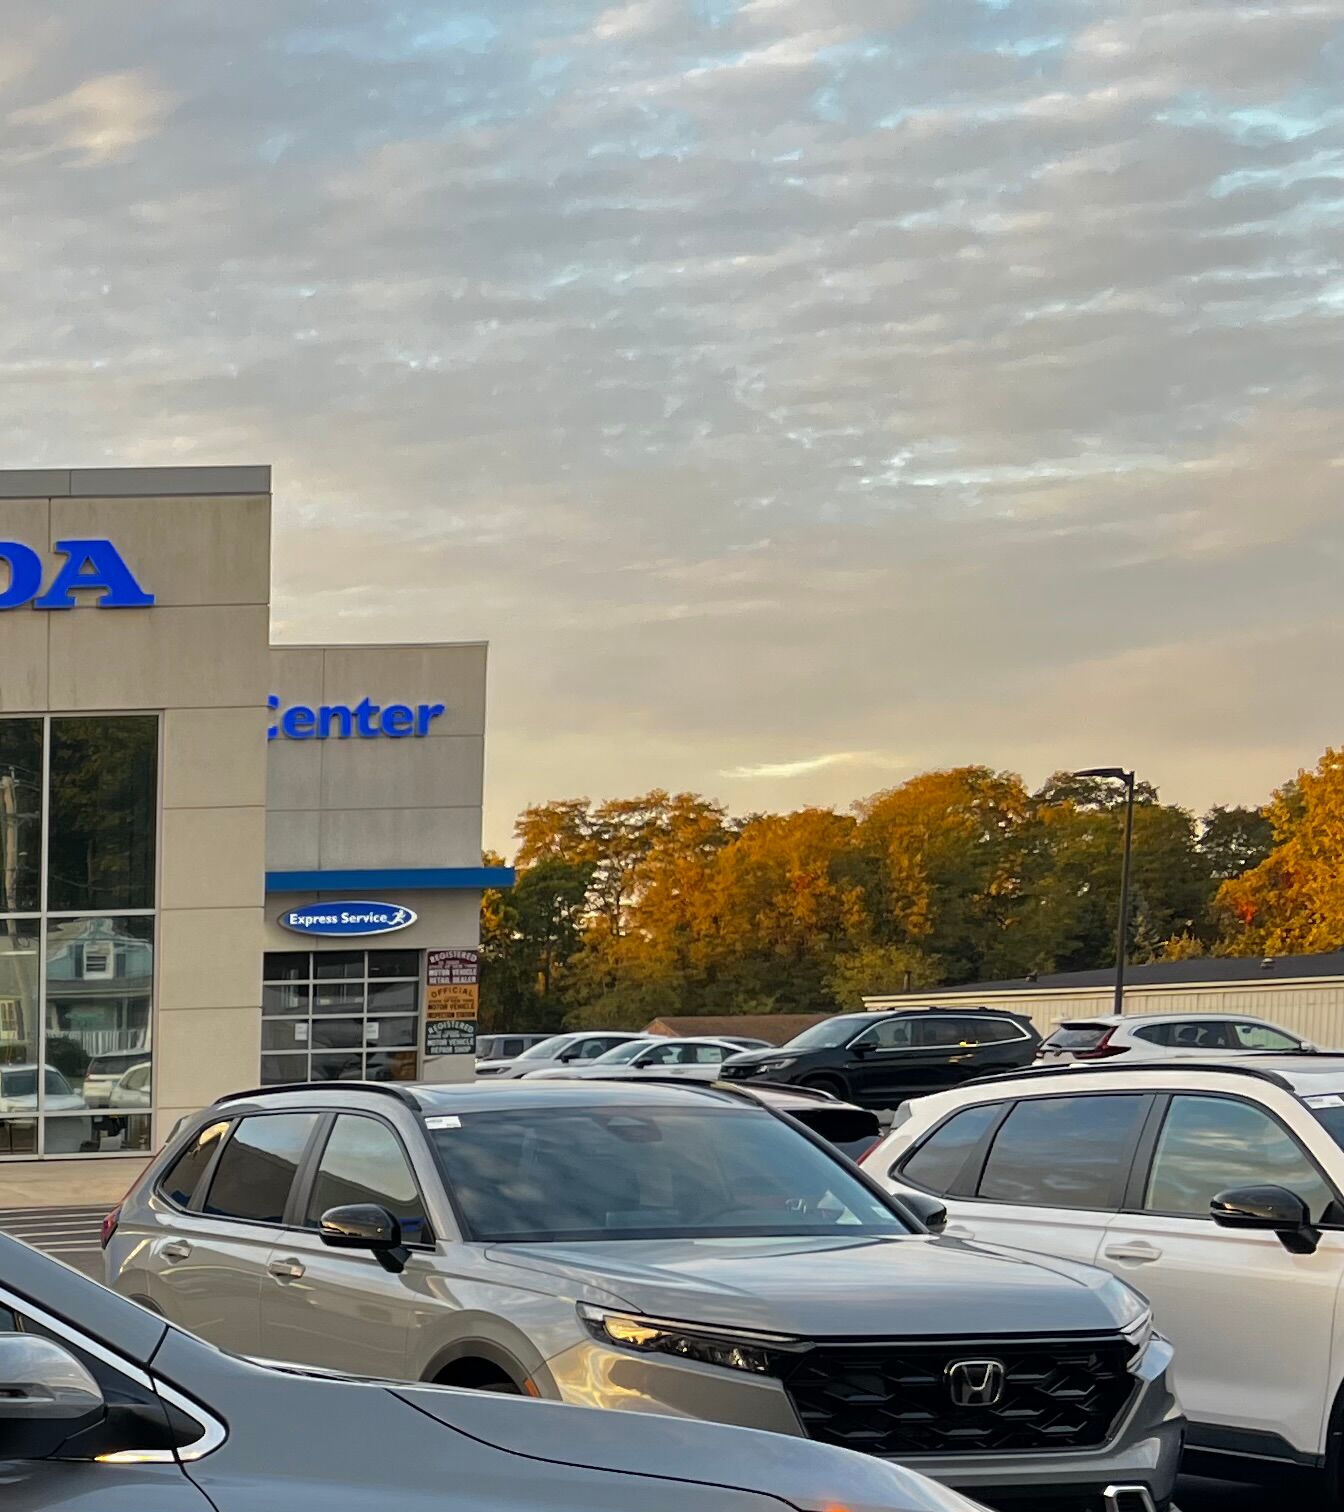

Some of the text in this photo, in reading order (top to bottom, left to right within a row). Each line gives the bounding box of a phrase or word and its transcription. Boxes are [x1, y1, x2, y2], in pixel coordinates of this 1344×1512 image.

[289, 911, 388, 927] Express Service
[429, 951, 477, 963] REGISTERED
[452, 968, 477, 976] VEHICLE
[431, 986, 474, 998] OFFICIAL
[428, 1021, 474, 1033] REGISTERED
